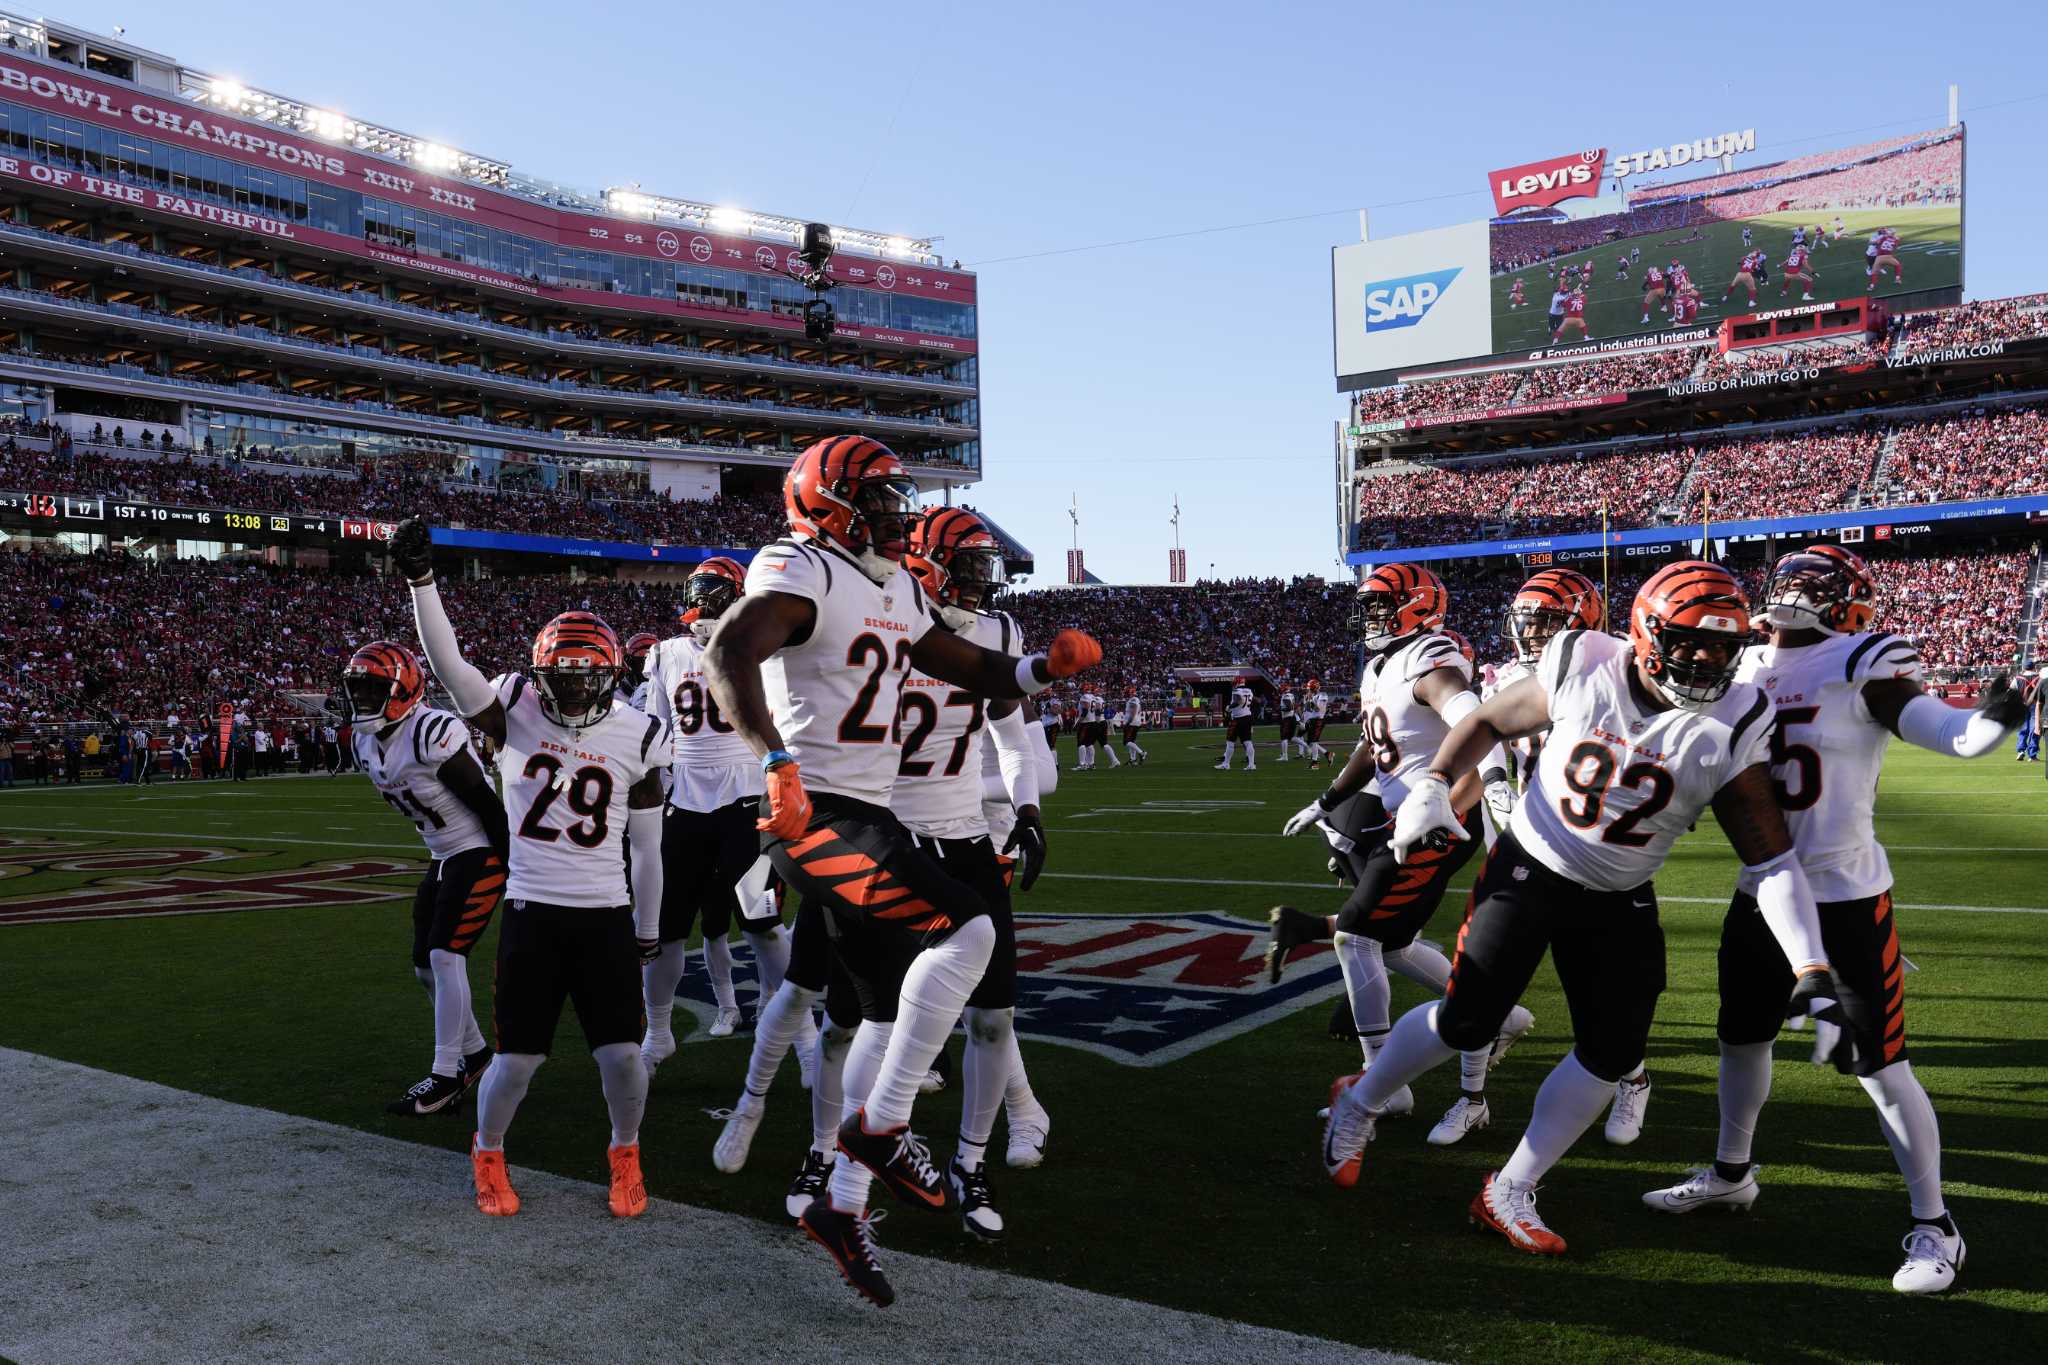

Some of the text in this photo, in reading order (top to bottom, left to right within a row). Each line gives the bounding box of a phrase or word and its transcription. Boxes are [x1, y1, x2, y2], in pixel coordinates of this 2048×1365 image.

[0, 66, 476, 212] BOWL CHAMPIONS XXIV XXIX
[1613, 128, 1756, 178] STADIUM
[30, 164, 72, 186] OF
[81, 175, 144, 203] THE
[156, 193, 295, 239] FAITHFUL
[588, 227, 609, 239] 52
[659, 238, 678, 250] 70
[691, 242, 711, 254] 73
[409, 258, 478, 281] CONFERENCE
[478, 274, 538, 294] CHAMPIONS
[1366, 282, 1438, 323] SAP
[1793, 303, 1836, 317] STADIUM
[834, 328, 861, 337] ALSH
[1600, 334, 1658, 352] Industrial
[1661, 327, 1710, 345] Internet
[1886, 343, 2004, 369] VZLAWFIRM.COM
[1667, 369, 1819, 397] INJURED OR HURT? GO TO
[1422, 415, 1455, 427] VENARDI
[1455, 411, 1488, 423] ZURADA
[1494, 408, 1512, 417] YOUR
[1512, 405, 1541, 415] FAITHFUL
[1542, 403, 1564, 411] INJURY
[1565, 397, 1602, 408] ATTORNEYS
[12, 499, 18, 507] 3
[78, 502, 91, 515] 17
[114, 505, 137, 519] 1ST
[151, 508, 168, 521] 10
[197, 512, 211, 523] 16
[224, 513, 261, 529] 13:08
[275, 519, 287, 530] 25
[318, 521, 326, 532] 4
[349, 523, 362, 535] 10
[1894, 525, 1931, 535] TOYOTA
[1527, 553, 1552, 565] 13:08
[1571, 545, 1671, 559] LEXUS GEICO
[904, 678, 951, 688] BENG
[898, 690, 984, 777] 27
[1593, 727, 1665, 761] BENALS
[1770, 705, 1823, 812] 5
[517, 752, 614, 849] 29
[1560, 740, 1675, 848] 92
